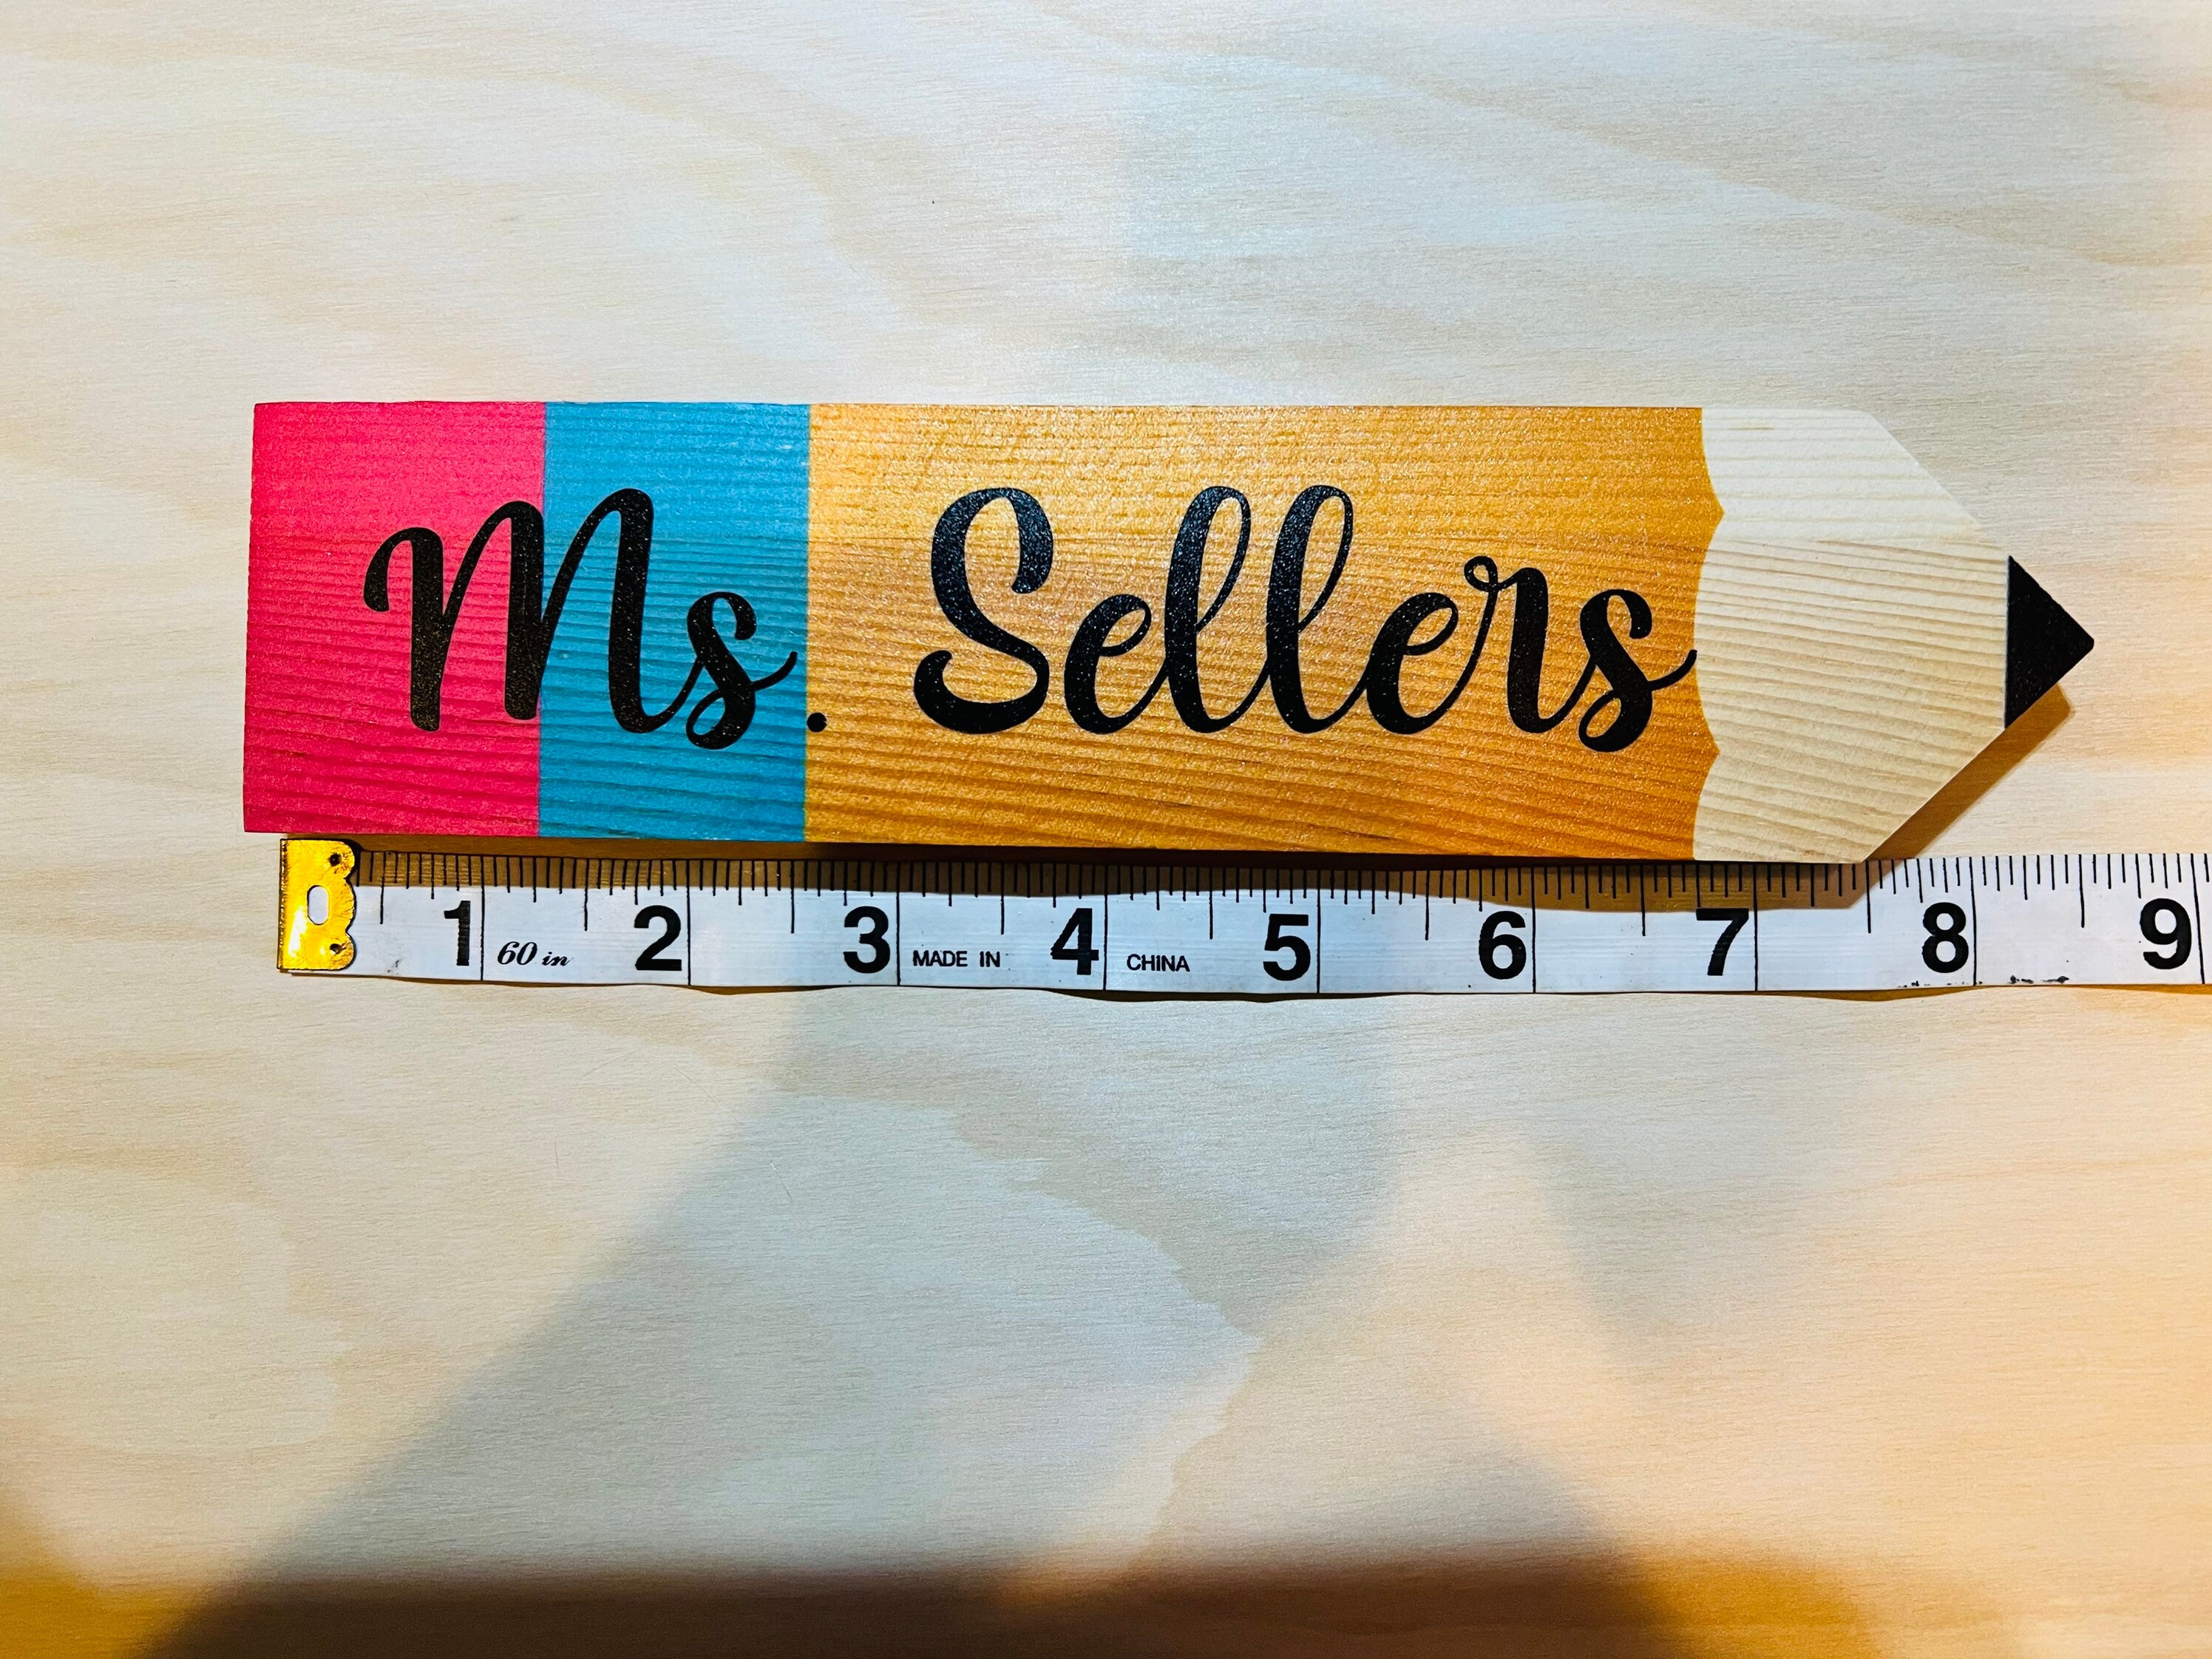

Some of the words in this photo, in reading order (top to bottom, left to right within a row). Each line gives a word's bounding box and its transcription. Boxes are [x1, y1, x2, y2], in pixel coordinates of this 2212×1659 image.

[363, 488, 827, 750] Ms.
[913, 484, 1697, 753] Sellers
[444, 900, 471, 966] 1
[497, 941, 537, 966] 60
[541, 950, 570, 967] in
[634, 905, 682, 971] 2
[843, 906, 891, 974] 3
[912, 950, 968, 967] MADE
[980, 951, 1000, 968] IN
[1126, 954, 1190, 972] CHINA
[1050, 907, 1099, 976] 4
[1262, 913, 1312, 982] 5
[1478, 910, 1527, 980] 6
[1694, 906, 1750, 977] 7
[1921, 902, 1970, 974] 8
[2139, 898, 2192, 970] 9
